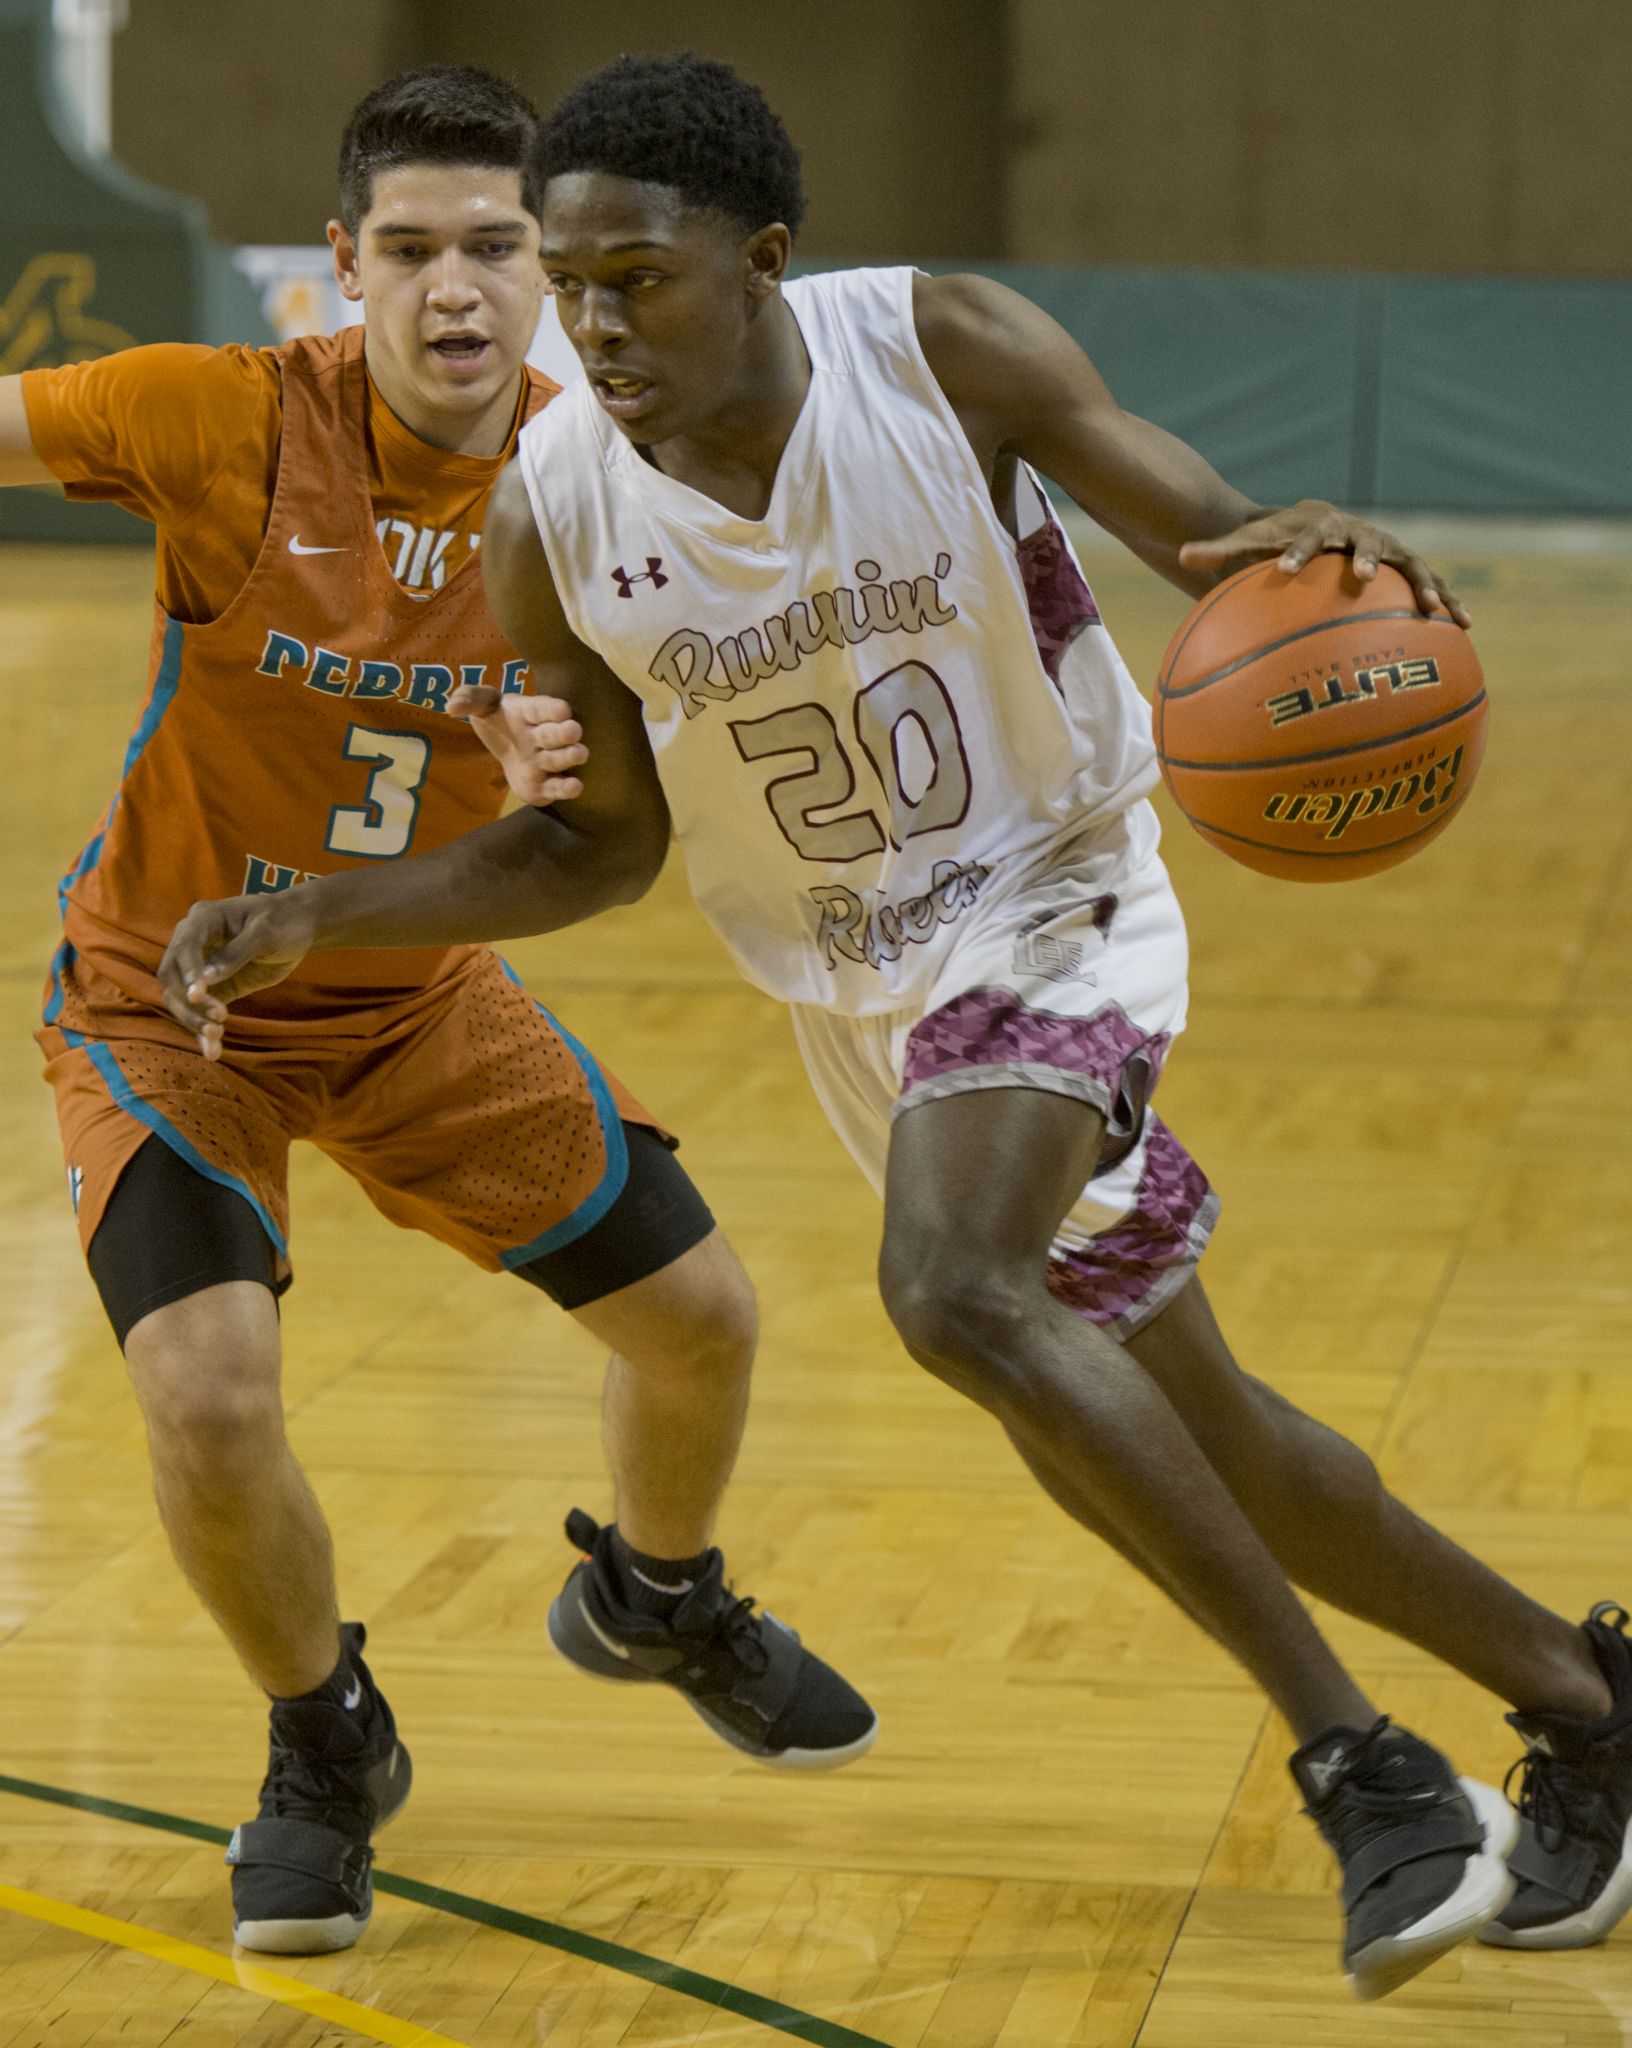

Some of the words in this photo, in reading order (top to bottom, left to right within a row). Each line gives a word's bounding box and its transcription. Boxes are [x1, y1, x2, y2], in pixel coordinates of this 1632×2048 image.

[648, 552, 957, 720] Runnin'
[1266, 657, 1440, 728] ELITE
[323, 722, 432, 861] 3
[726, 660, 972, 863] 20
[1263, 743, 1464, 840] Baden
[1308, 749, 1435, 788] PERFECTION
